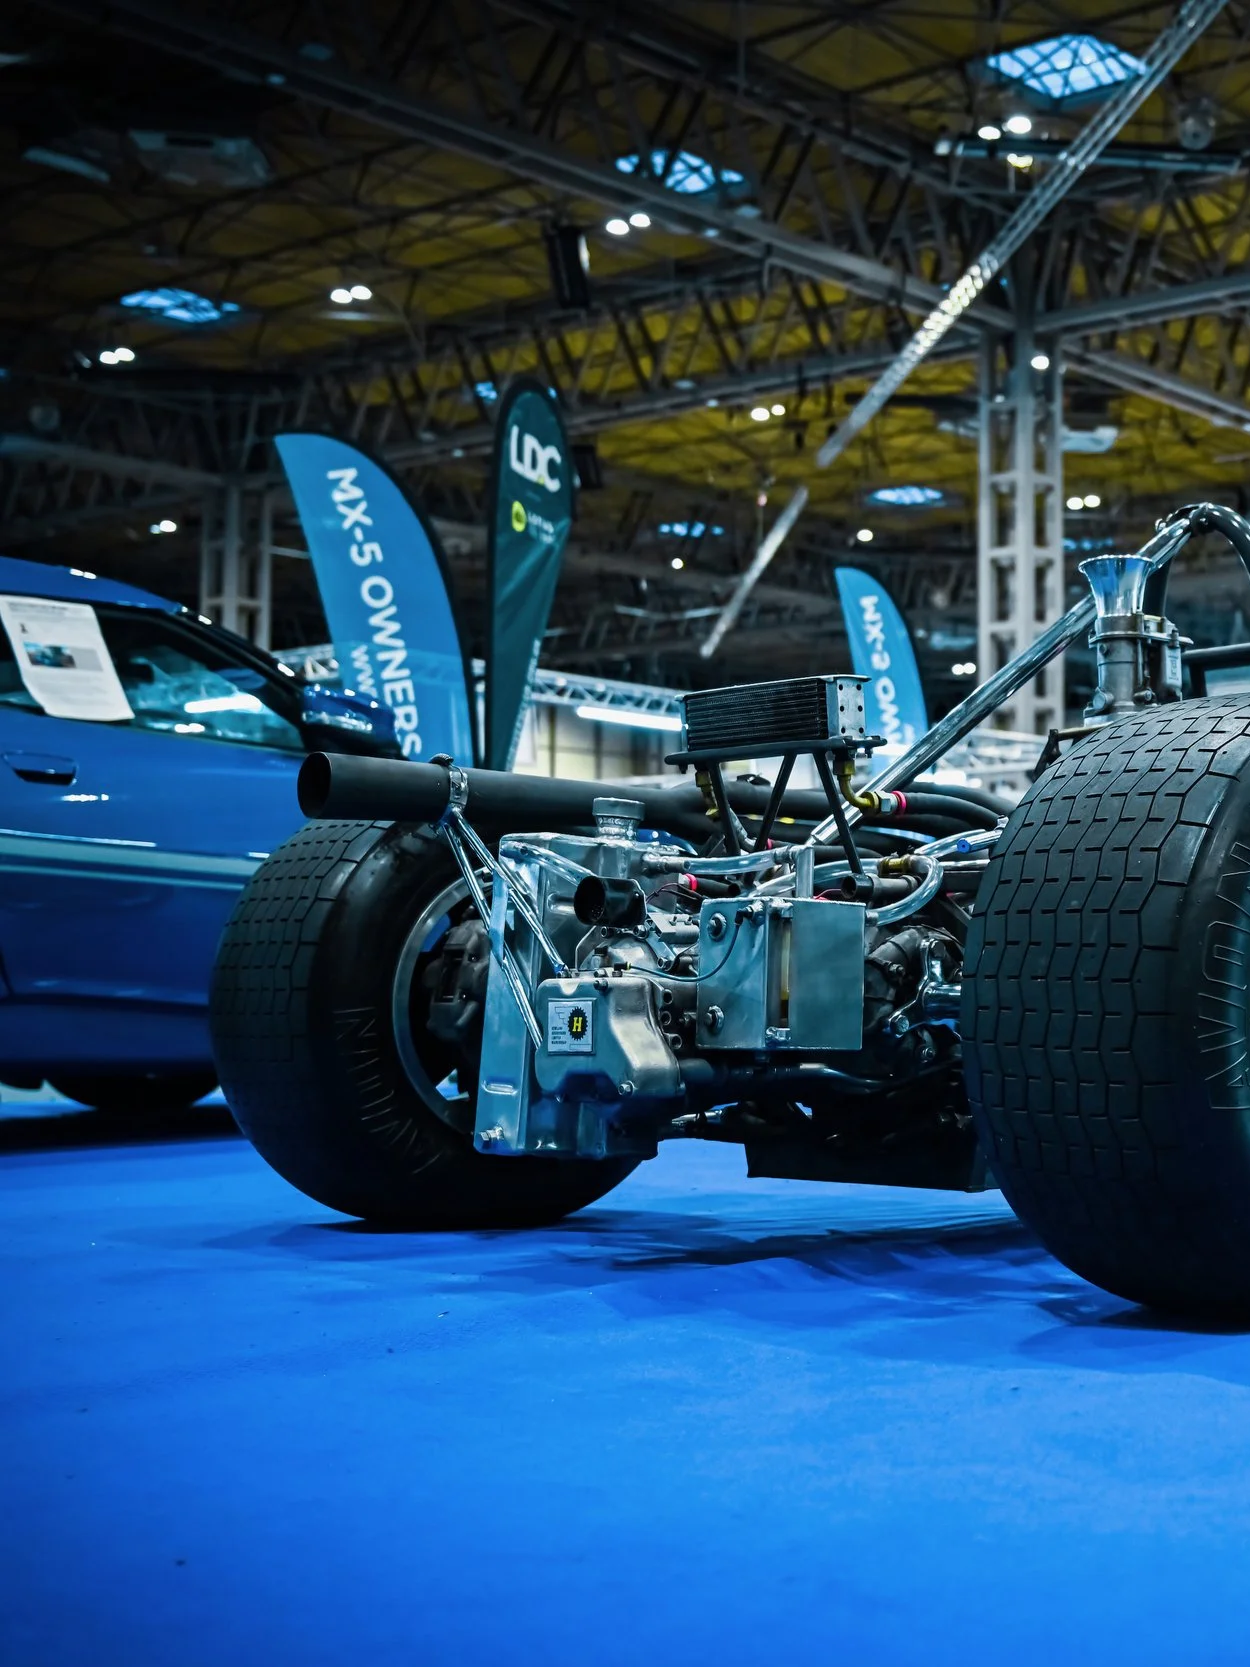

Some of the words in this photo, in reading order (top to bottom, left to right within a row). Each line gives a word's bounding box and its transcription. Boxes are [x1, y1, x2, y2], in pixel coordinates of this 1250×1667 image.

[510, 424, 561, 493] LDC
[326, 467, 383, 567] MX-5
[360, 575, 422, 757] OWNERS
[572, 1016, 583, 1032] H
